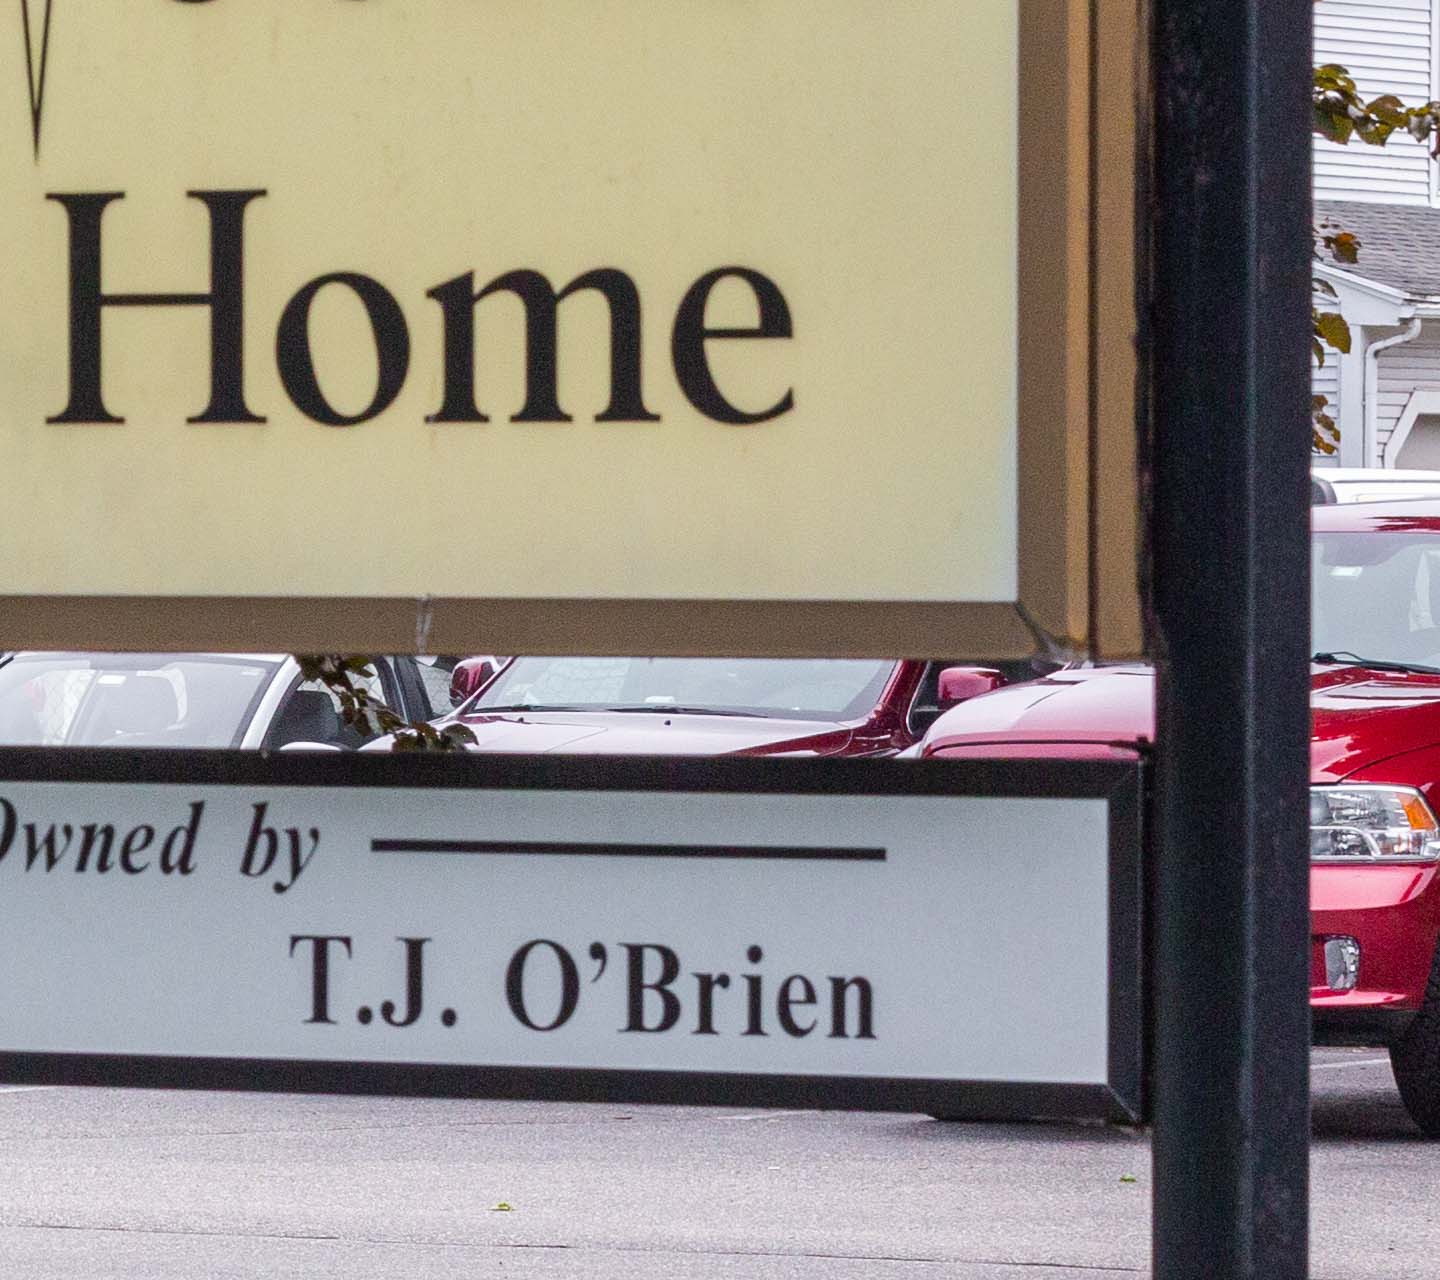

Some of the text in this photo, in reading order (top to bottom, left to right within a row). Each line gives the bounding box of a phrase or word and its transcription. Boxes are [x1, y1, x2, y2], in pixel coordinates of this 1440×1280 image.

[45, 188, 795, 428] Home
[239, 801, 321, 894] by
[289, 934, 878, 1040] T.J. O'Brien
